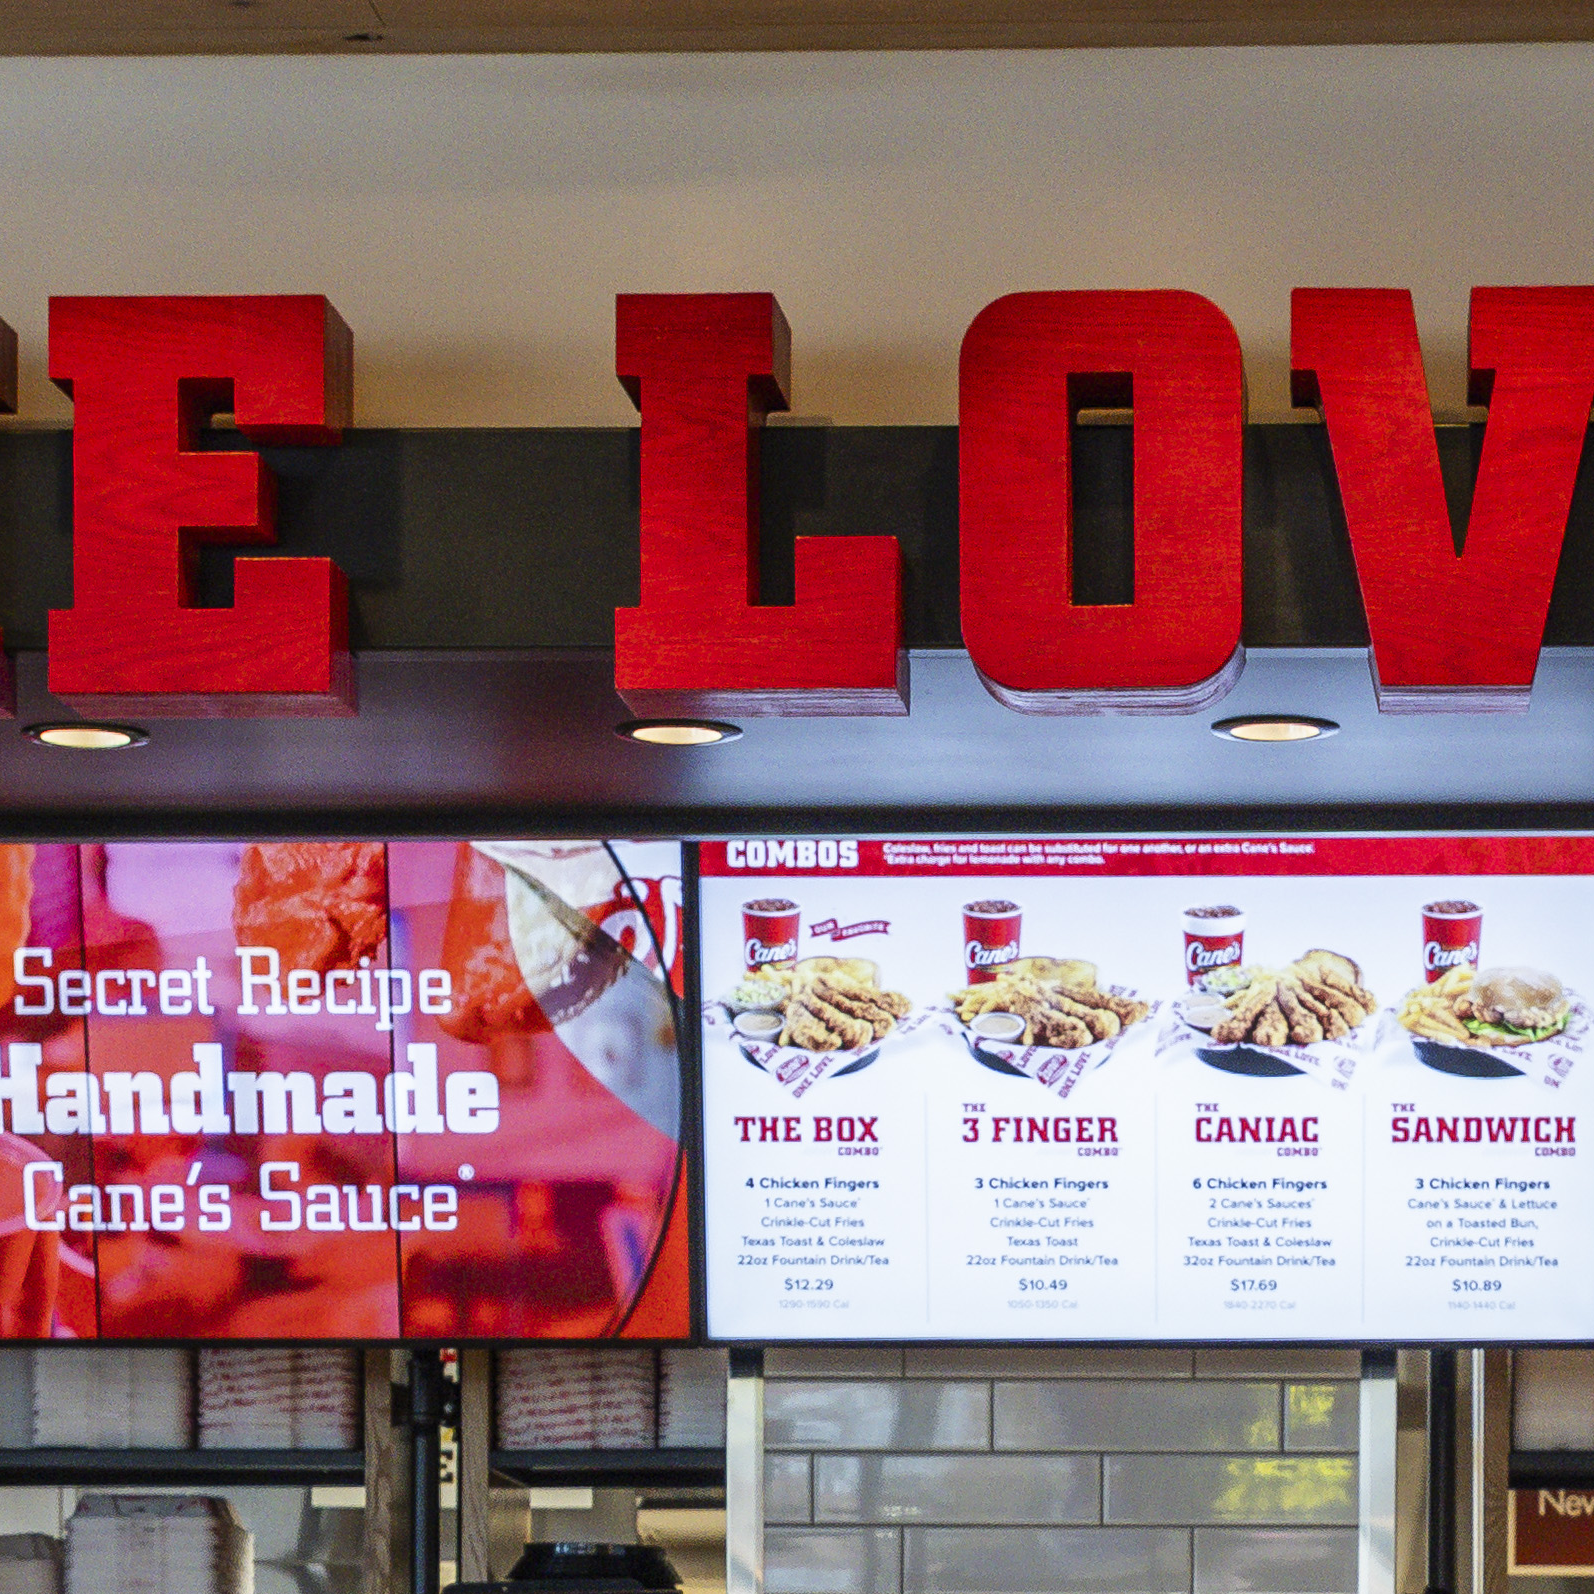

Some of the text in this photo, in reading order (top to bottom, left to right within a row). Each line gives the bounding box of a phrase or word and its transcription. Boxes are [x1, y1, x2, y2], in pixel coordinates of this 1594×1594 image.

[727, 841, 859, 868] COMBOS
[14, 946, 452, 1031] Secret Recipe
[734, 1117, 878, 1142] THE BOX
[963, 1117, 1118, 1142] 3 FINGER
[1196, 1117, 1318, 1142] CANIAC
[1392, 1117, 1575, 1142] SANDWICH
[838, 1147, 879, 1156] COMBO
[1078, 1147, 1119, 1156] COMBO
[1277, 1147, 1318, 1156] COMBO
[1535, 1147, 1576, 1156] COMBO
[745, 1177, 879, 1192] 4 Chicken Fingers
[976, 1178, 1109, 1192] 3 Chicken Fingers
[1193, 1178, 1327, 1192] 6 Chicken Fingers
[1416, 1178, 1550, 1192] 3 Chicken Fingers
[23, 1162, 231, 1232] Cane's
[761, 1216, 864, 1227] Crinkle-Cut Fries
[742, 1236, 884, 1246] Texas Toast & Coleslaw
[738, 1254, 889, 1266] 22oz Fountain Drink/Tea
[785, 1278, 834, 1291] $12.29
[1019, 1278, 1068, 1291] $10.49
[1231, 1279, 1277, 1292] $17.69
[1453, 1279, 1502, 1292] $10.89
